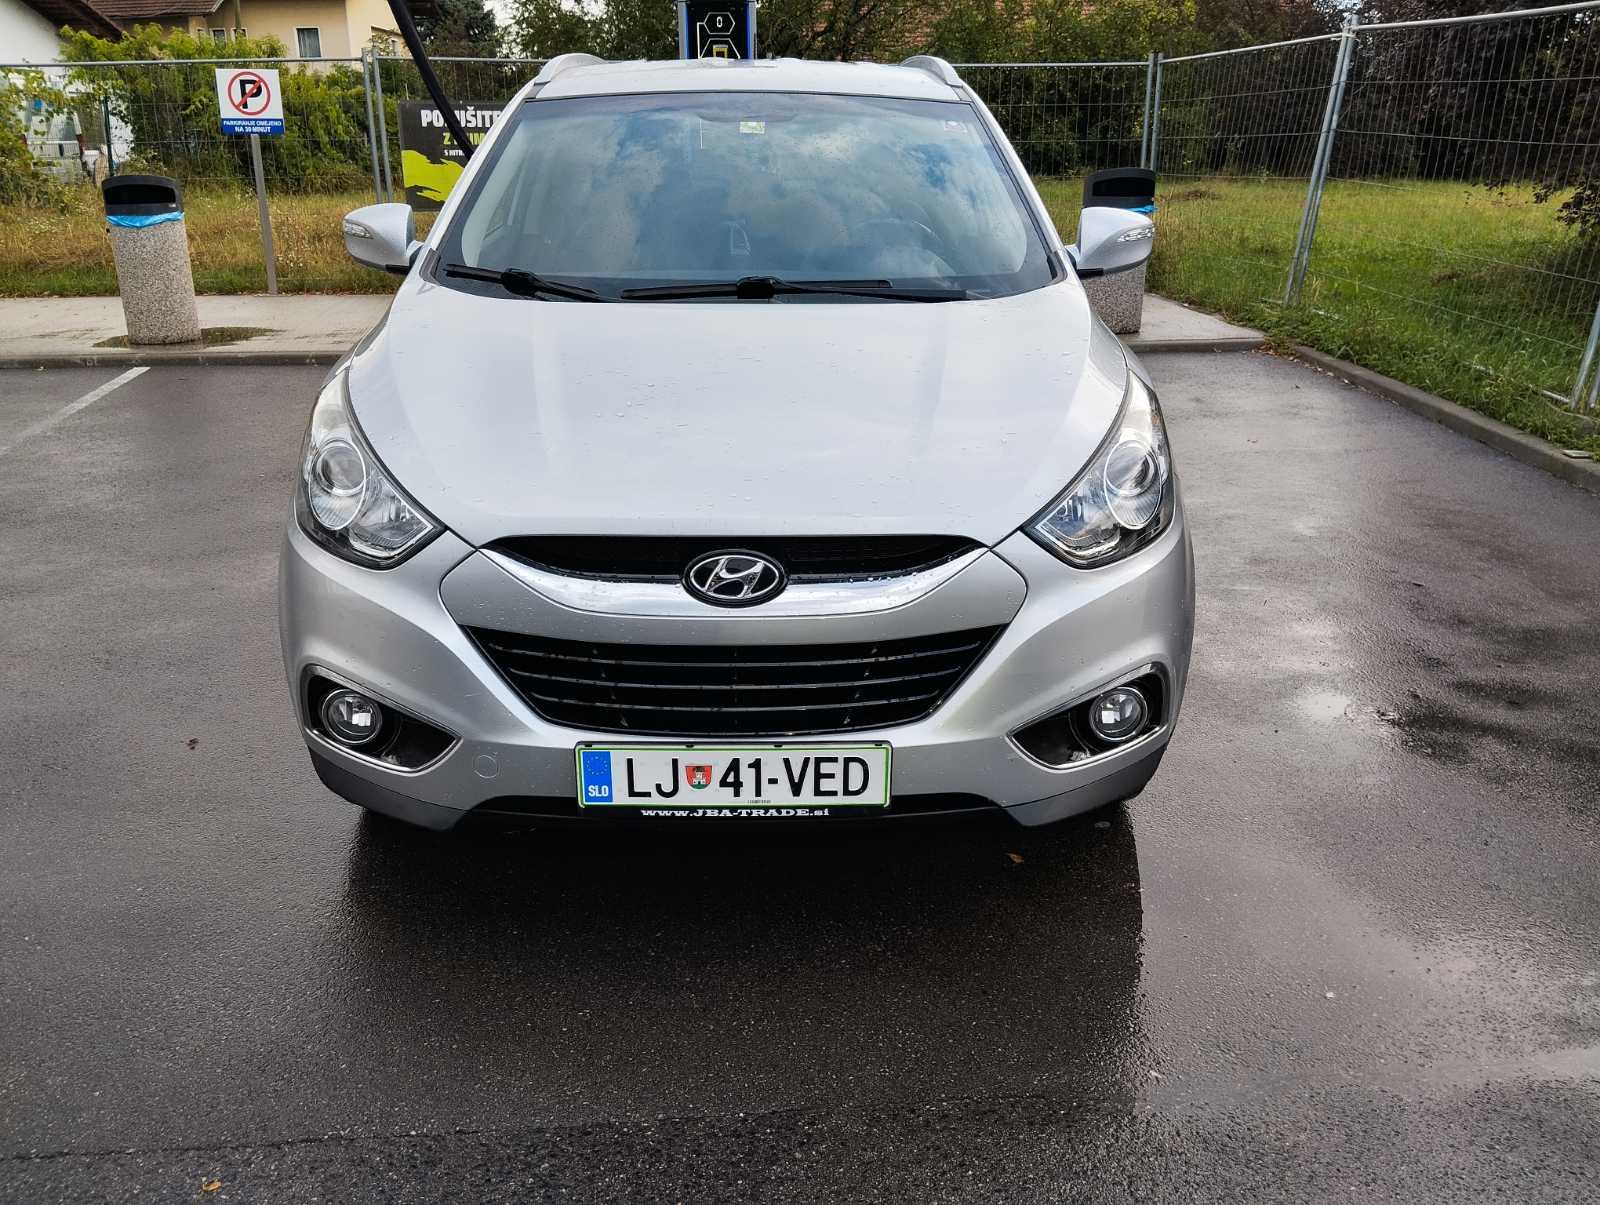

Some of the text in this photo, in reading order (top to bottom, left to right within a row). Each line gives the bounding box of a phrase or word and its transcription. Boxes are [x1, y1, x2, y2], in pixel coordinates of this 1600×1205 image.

[716, 16, 723, 28] 0
[420, 106, 502, 128] POUŠIT
[626, 756, 870, 798] LJ 41-VED
[588, 785, 609, 797] SLO
[640, 808, 830, 817] www.JBA-TRADE.si
